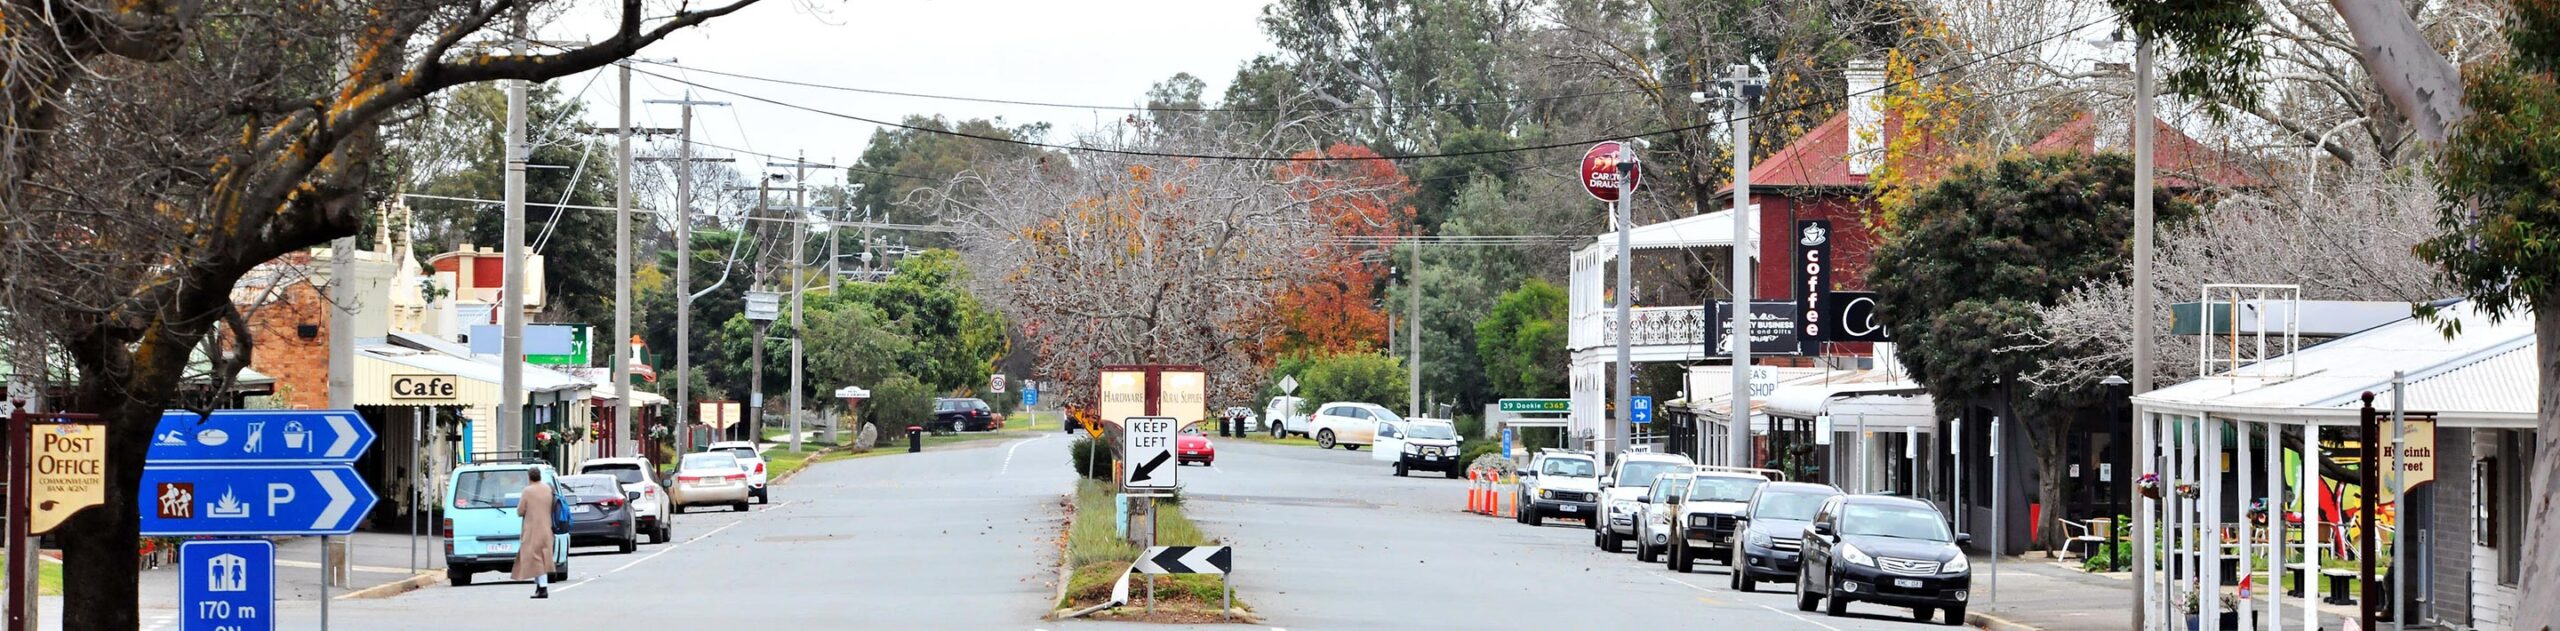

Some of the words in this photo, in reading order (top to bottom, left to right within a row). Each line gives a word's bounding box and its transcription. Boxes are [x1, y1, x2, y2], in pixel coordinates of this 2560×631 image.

[1592, 172, 1620, 180] CARLT
[1590, 180, 1620, 188] DRAUG
[394, 377, 453, 396] Cafe
[1103, 391, 1144, 403] HARDWARE
[1134, 422, 1168, 433] KEEP
[44, 433, 94, 453] POST
[1135, 437, 1166, 447] LEFT
[38, 454, 99, 475] OFFICE
[199, 600, 230, 619] 170
[238, 606, 256, 619] m
